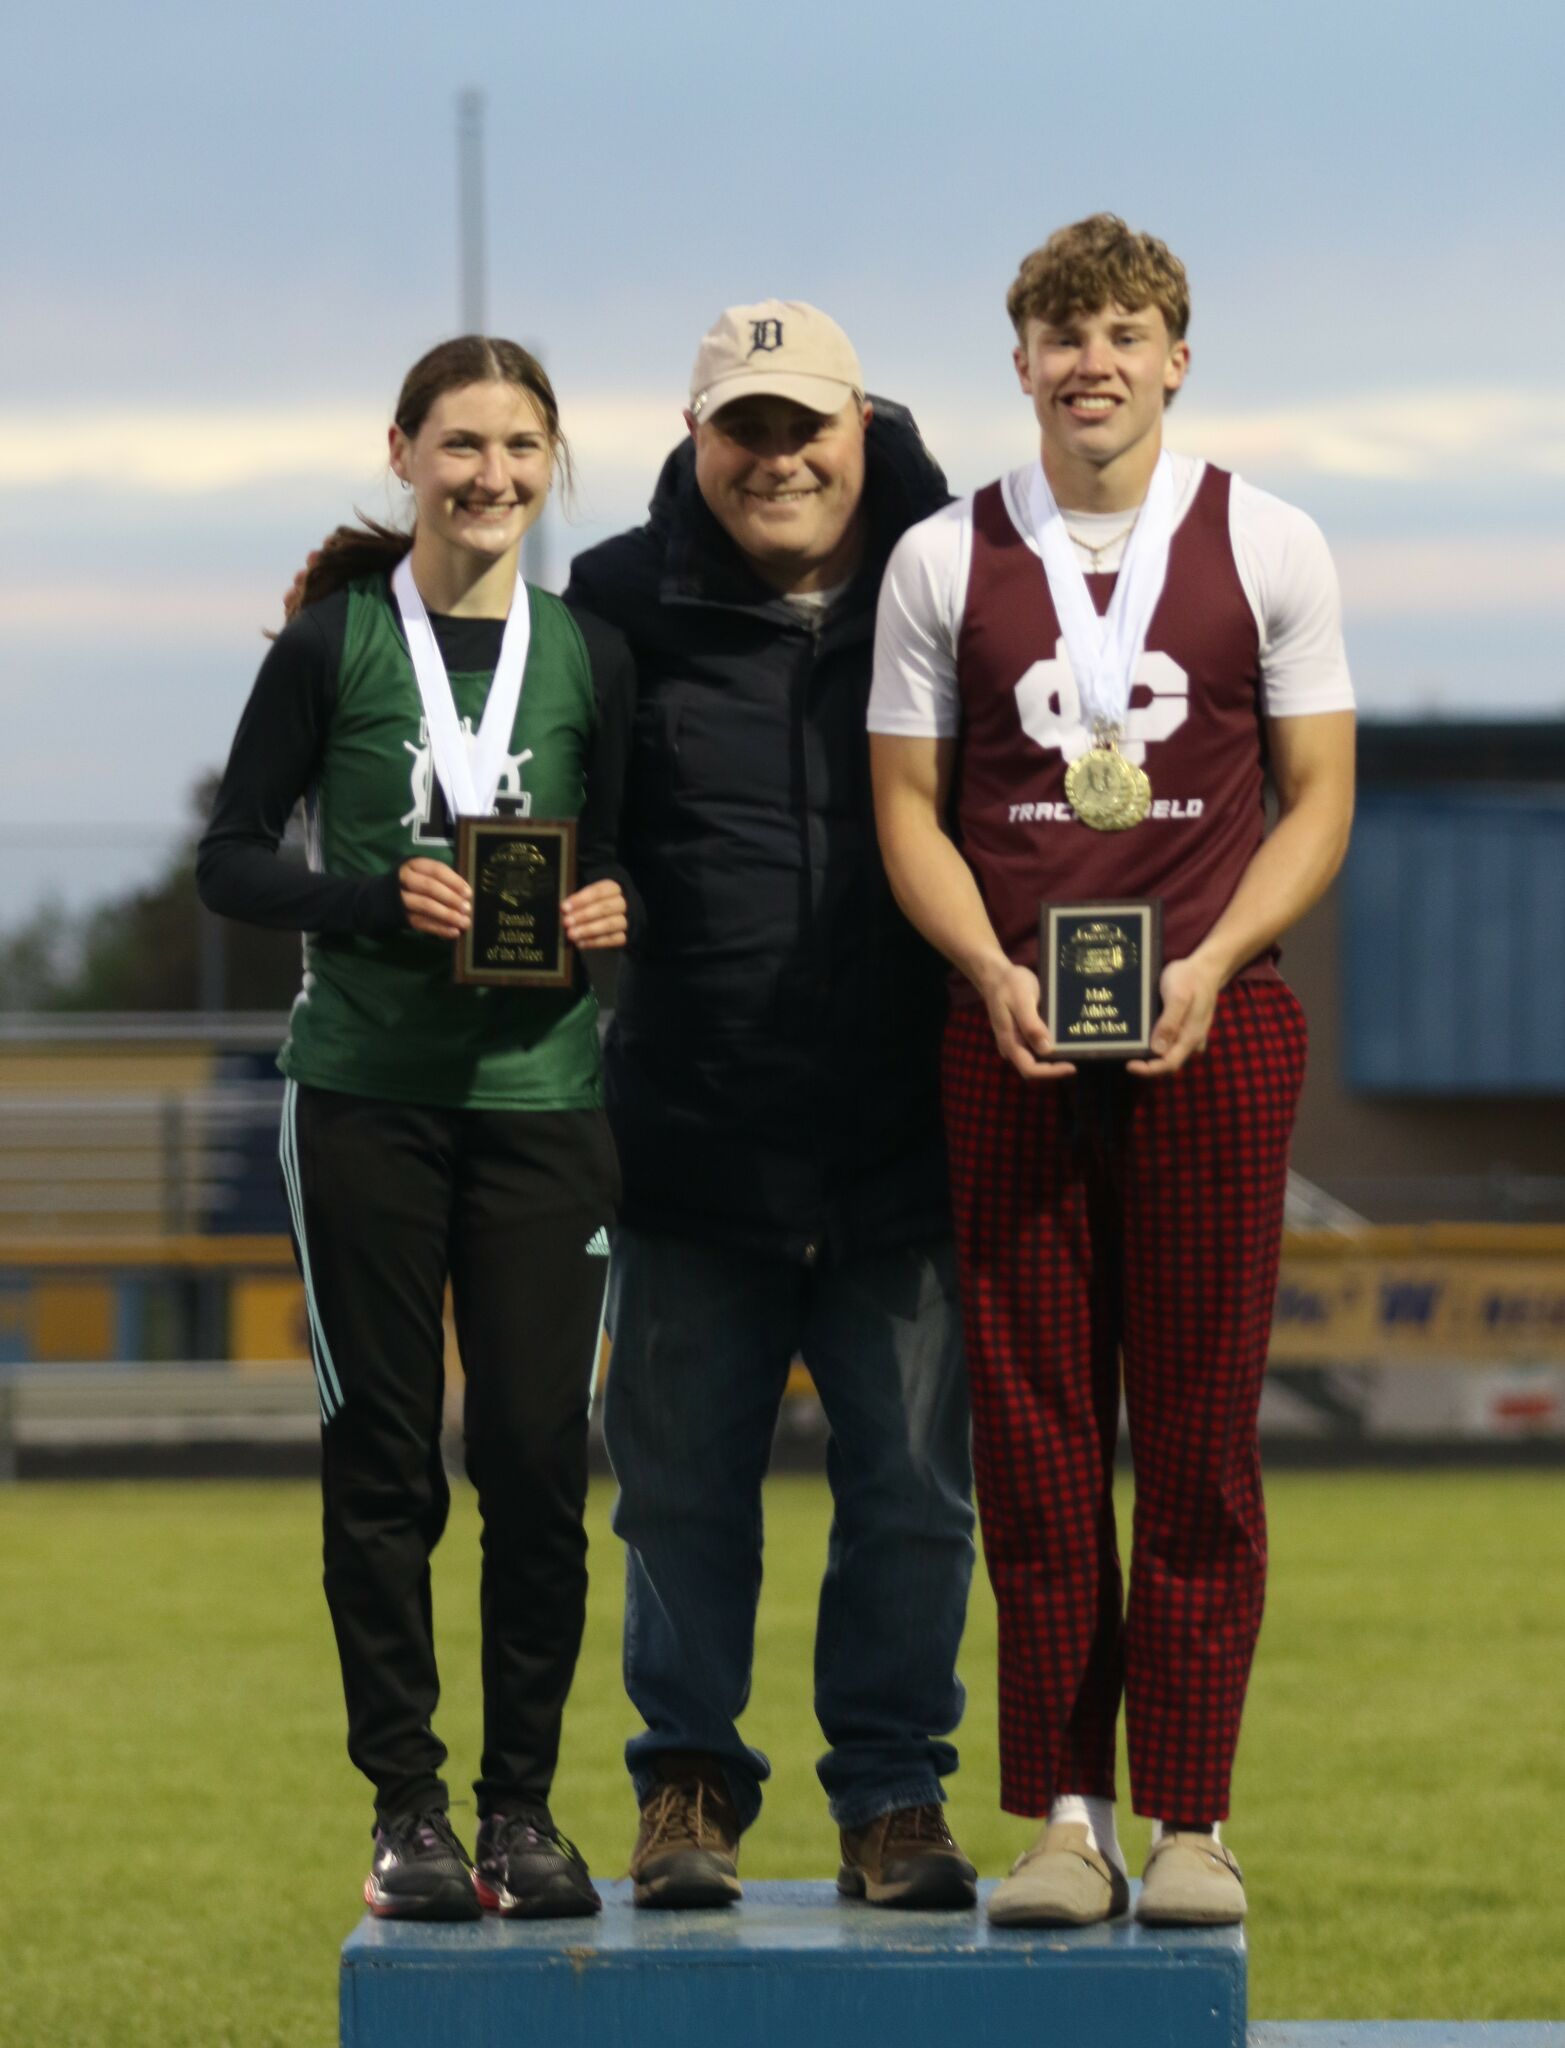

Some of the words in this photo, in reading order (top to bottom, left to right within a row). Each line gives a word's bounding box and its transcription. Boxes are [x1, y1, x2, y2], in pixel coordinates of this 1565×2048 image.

[746, 318, 784, 360] D
[1009, 802, 1079, 823] TRAC
[1085, 986, 1113, 1001] Male
[1081, 1003, 1119, 1018] Athlete
[1068, 1021, 1081, 1034] of
[1082, 1020, 1099, 1034] the
[1100, 1020, 1127, 1034] Meet
